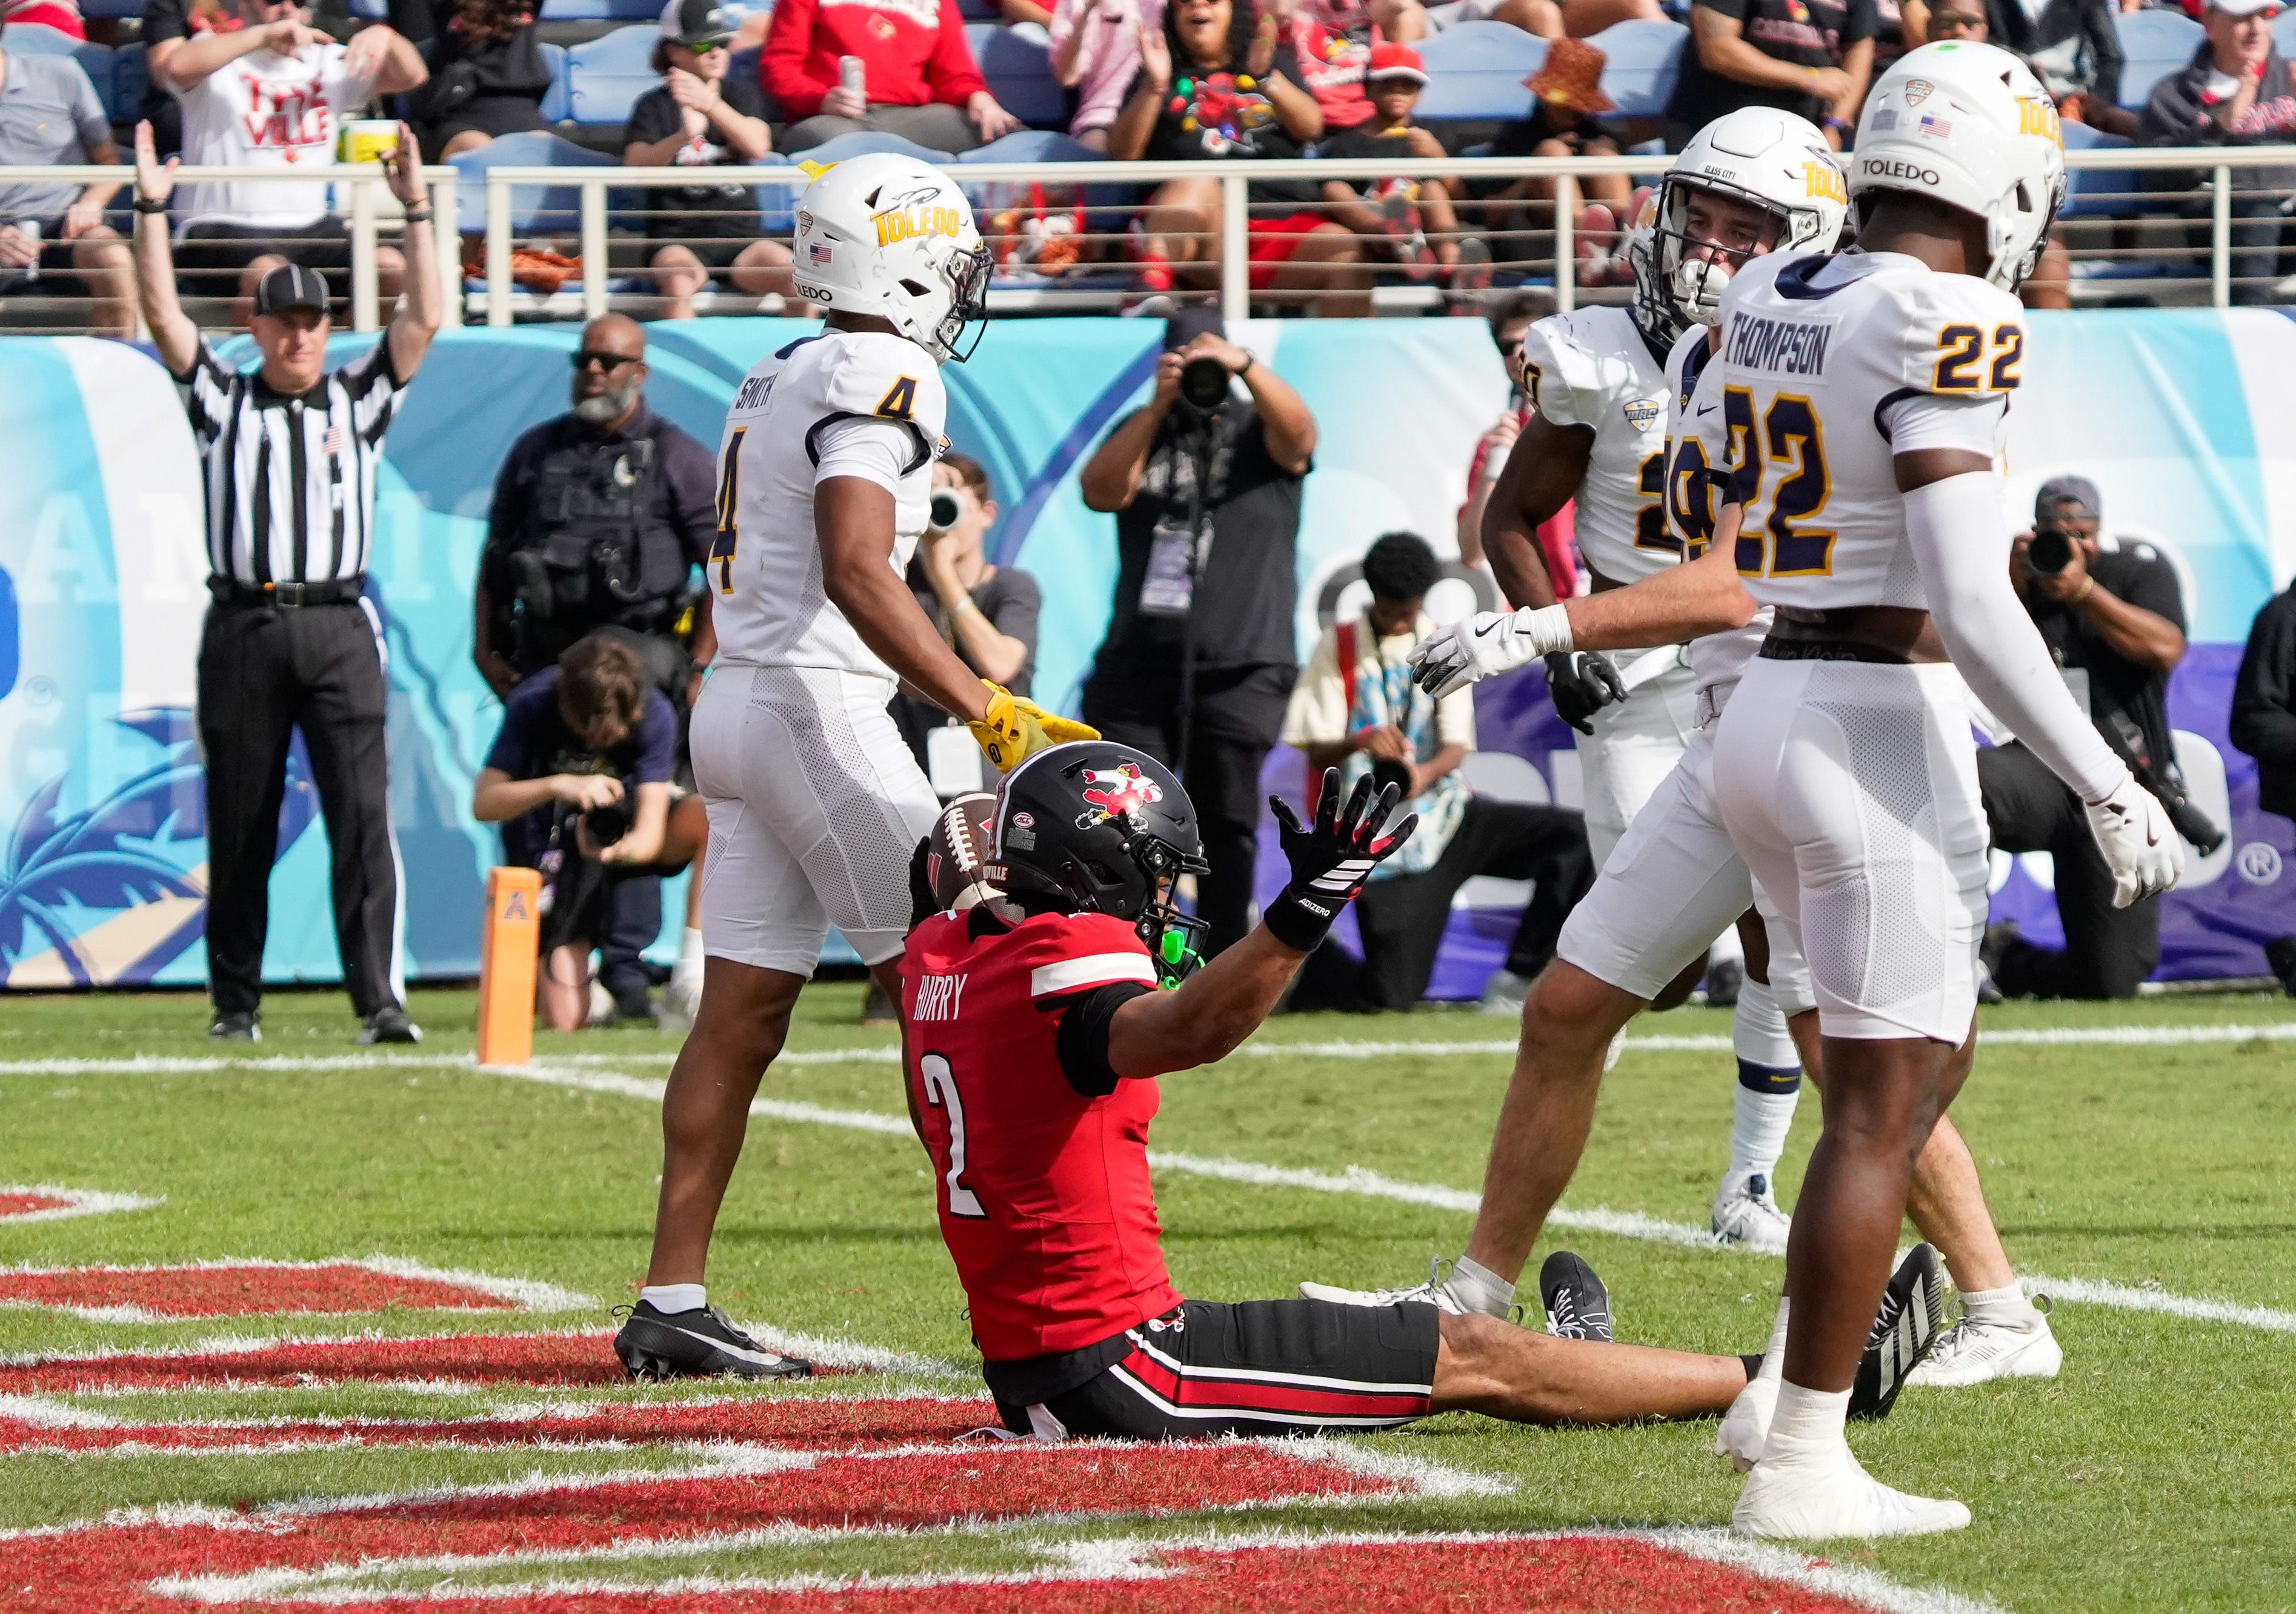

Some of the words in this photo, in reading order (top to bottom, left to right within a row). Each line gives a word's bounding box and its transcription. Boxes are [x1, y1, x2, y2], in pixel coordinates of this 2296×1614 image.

[1722, 169, 1737, 180] CITY
[1863, 159, 1941, 185] TOLEDO
[870, 206, 959, 247] TOLEDO
[1725, 310, 1831, 375] THOMPSON
[1931, 322, 2022, 393] 22
[735, 372, 779, 410] SMITH
[873, 374, 919, 421] 4
[1725, 384, 1837, 578] 22
[710, 426, 748, 594] 4
[1299, 898, 1331, 917] ADIZERO
[913, 973, 968, 1021] HURRY
[920, 1050, 989, 1220] 2
